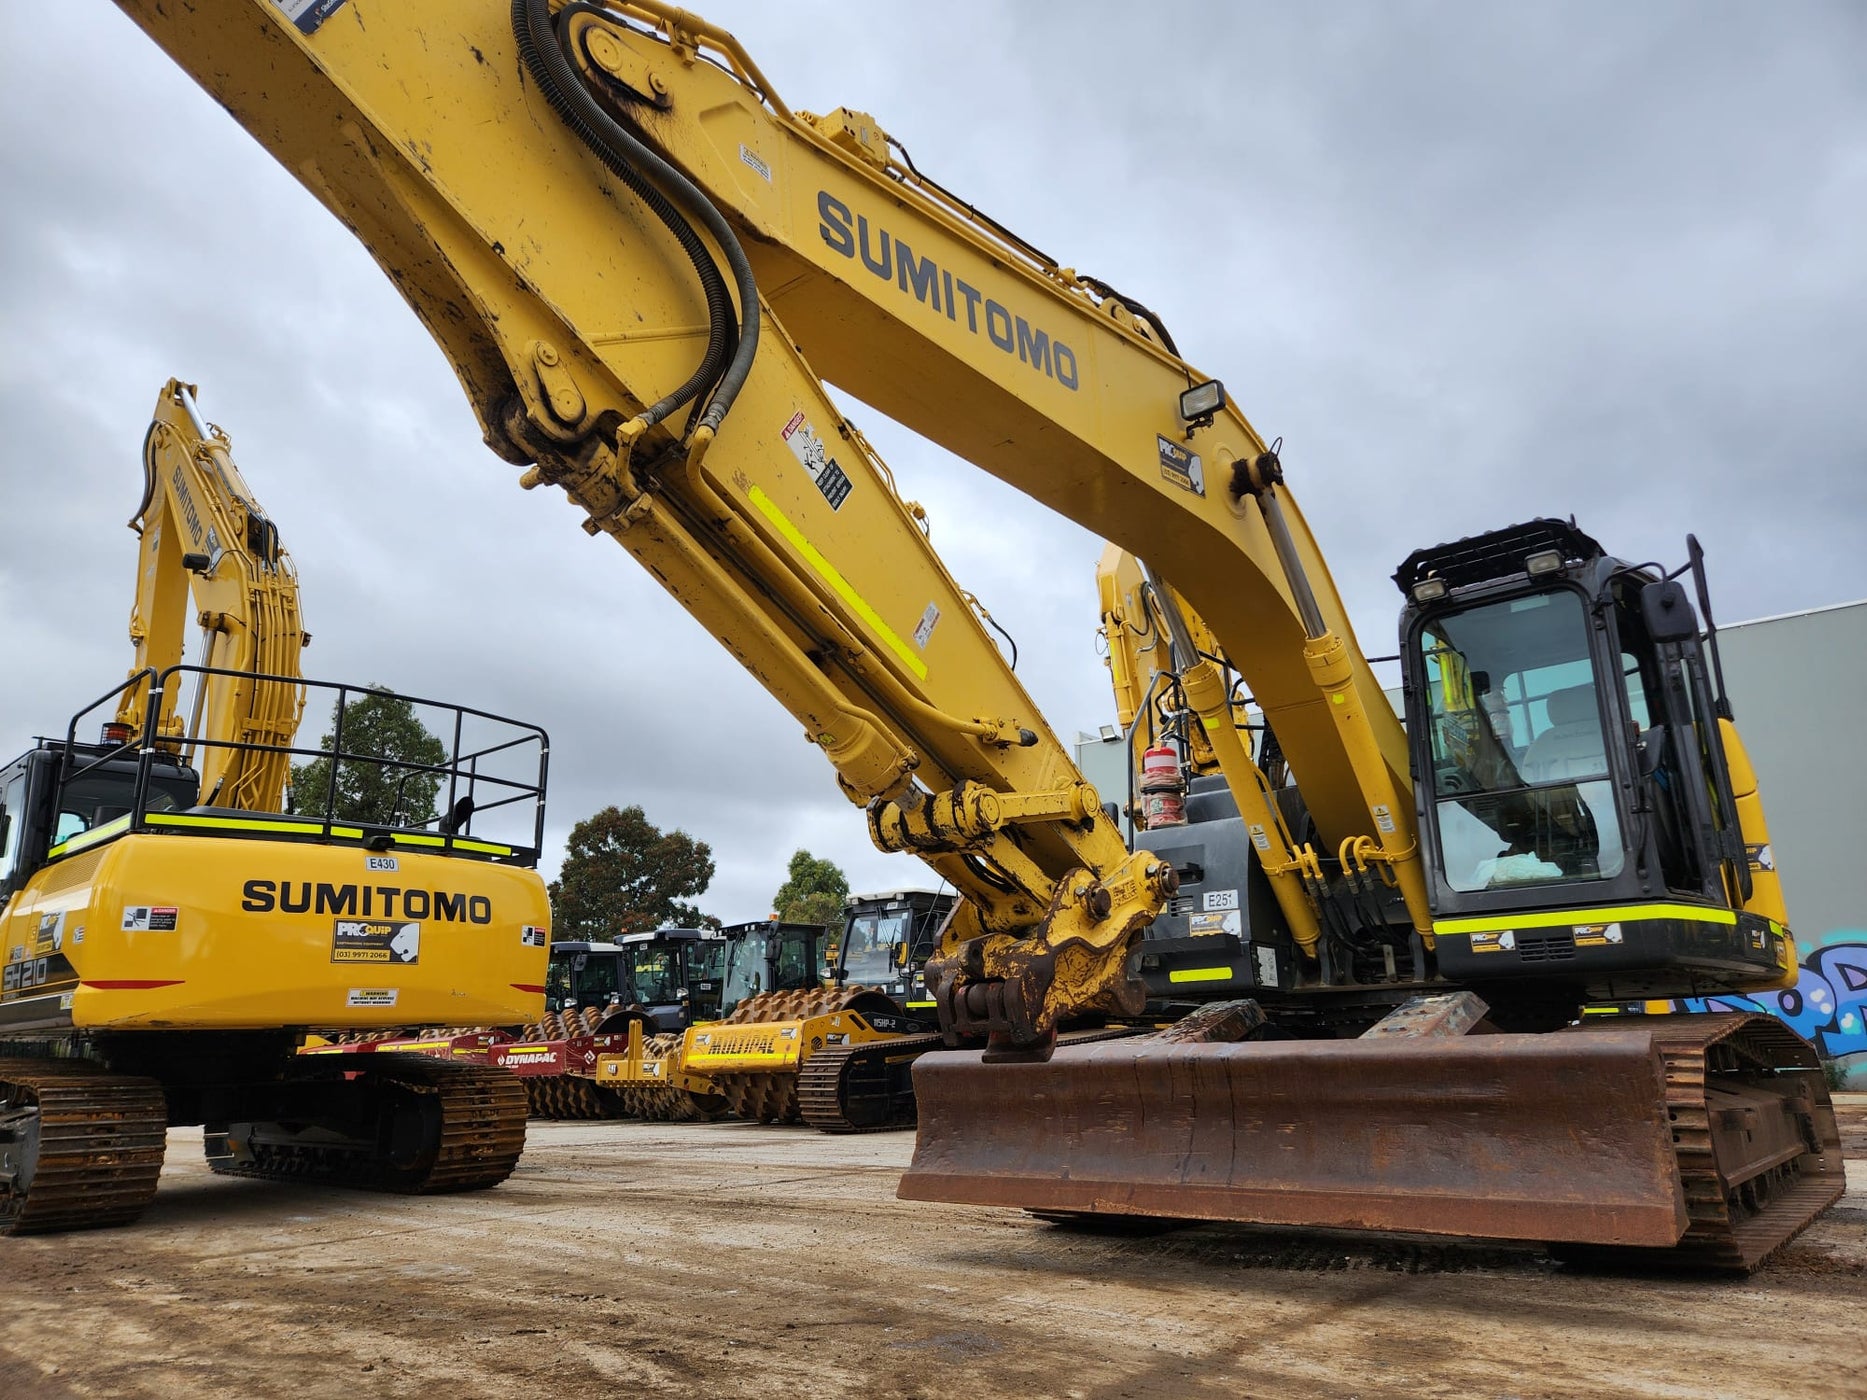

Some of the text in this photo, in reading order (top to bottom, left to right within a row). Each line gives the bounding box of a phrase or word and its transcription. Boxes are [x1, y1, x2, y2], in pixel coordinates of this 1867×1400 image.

[818, 190, 1079, 392] SUMITOMO
[173, 464, 203, 547] SUMITOMO
[370, 858, 395, 869] E430
[242, 880, 491, 924] SUMITOMO
[1209, 894, 1232, 907] E251
[337, 922, 392, 936] PROQUIP
[709, 1033, 779, 1054] MULTIPAC
[505, 1052, 557, 1064] DYNAPAC
